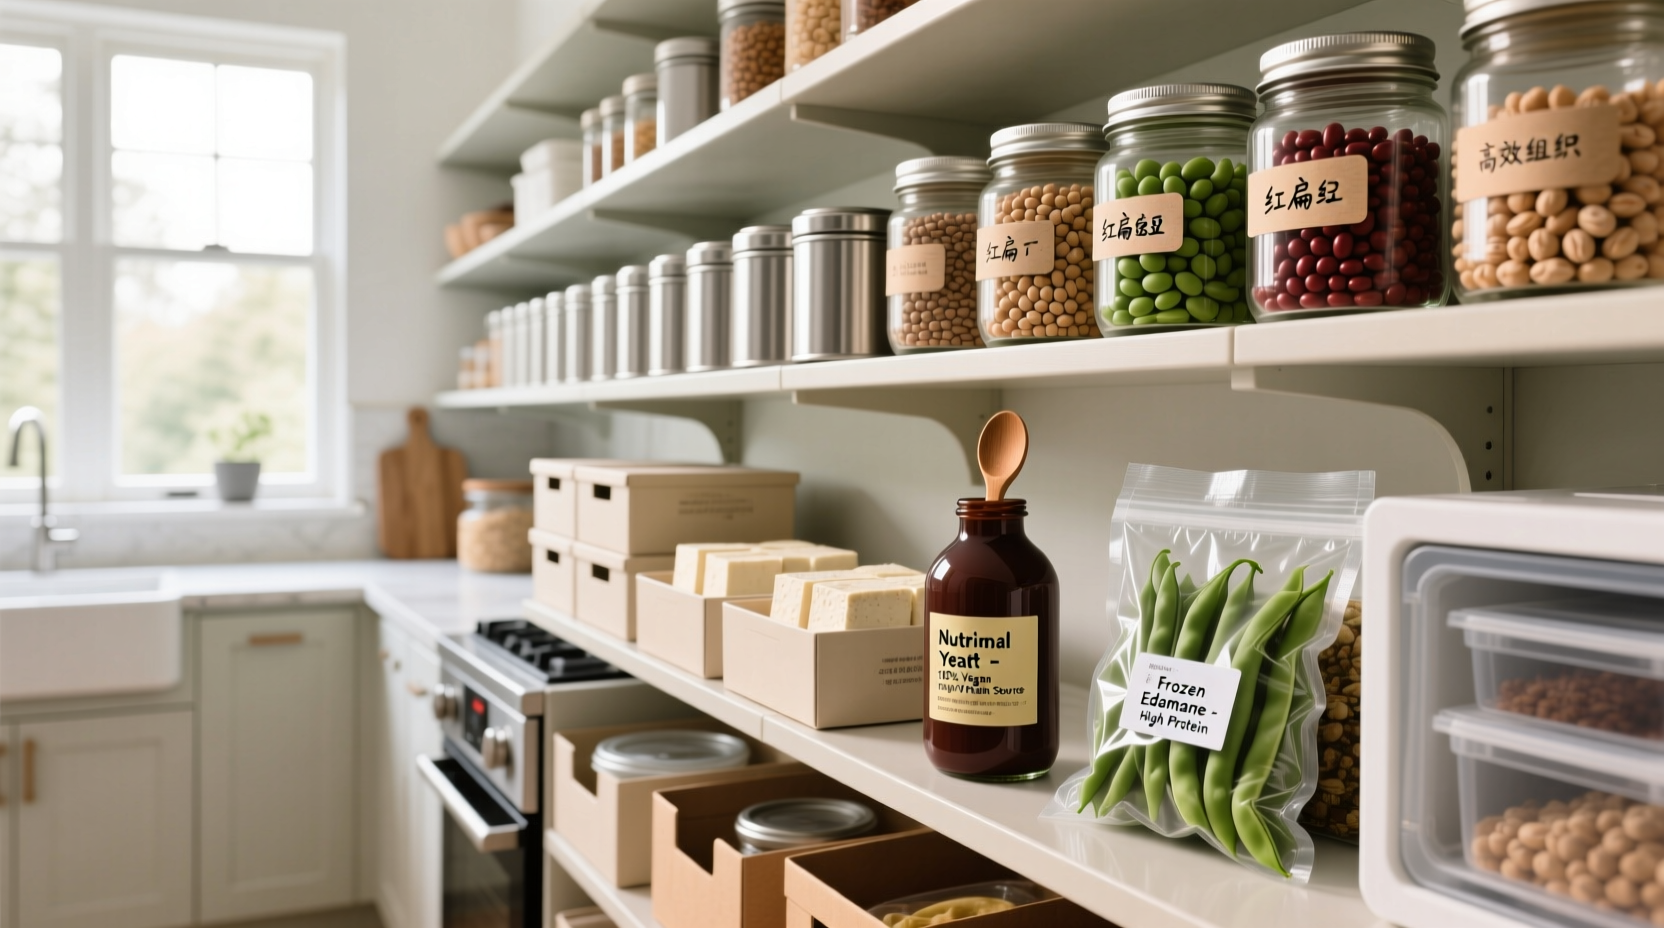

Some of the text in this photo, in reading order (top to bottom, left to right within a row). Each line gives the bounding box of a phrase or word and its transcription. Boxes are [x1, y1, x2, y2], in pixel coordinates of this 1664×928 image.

[1479, 133, 1581, 173] 高效组织
[1157, 676, 1206, 698] Frozen
[1167, 715, 1208, 735] Protein
